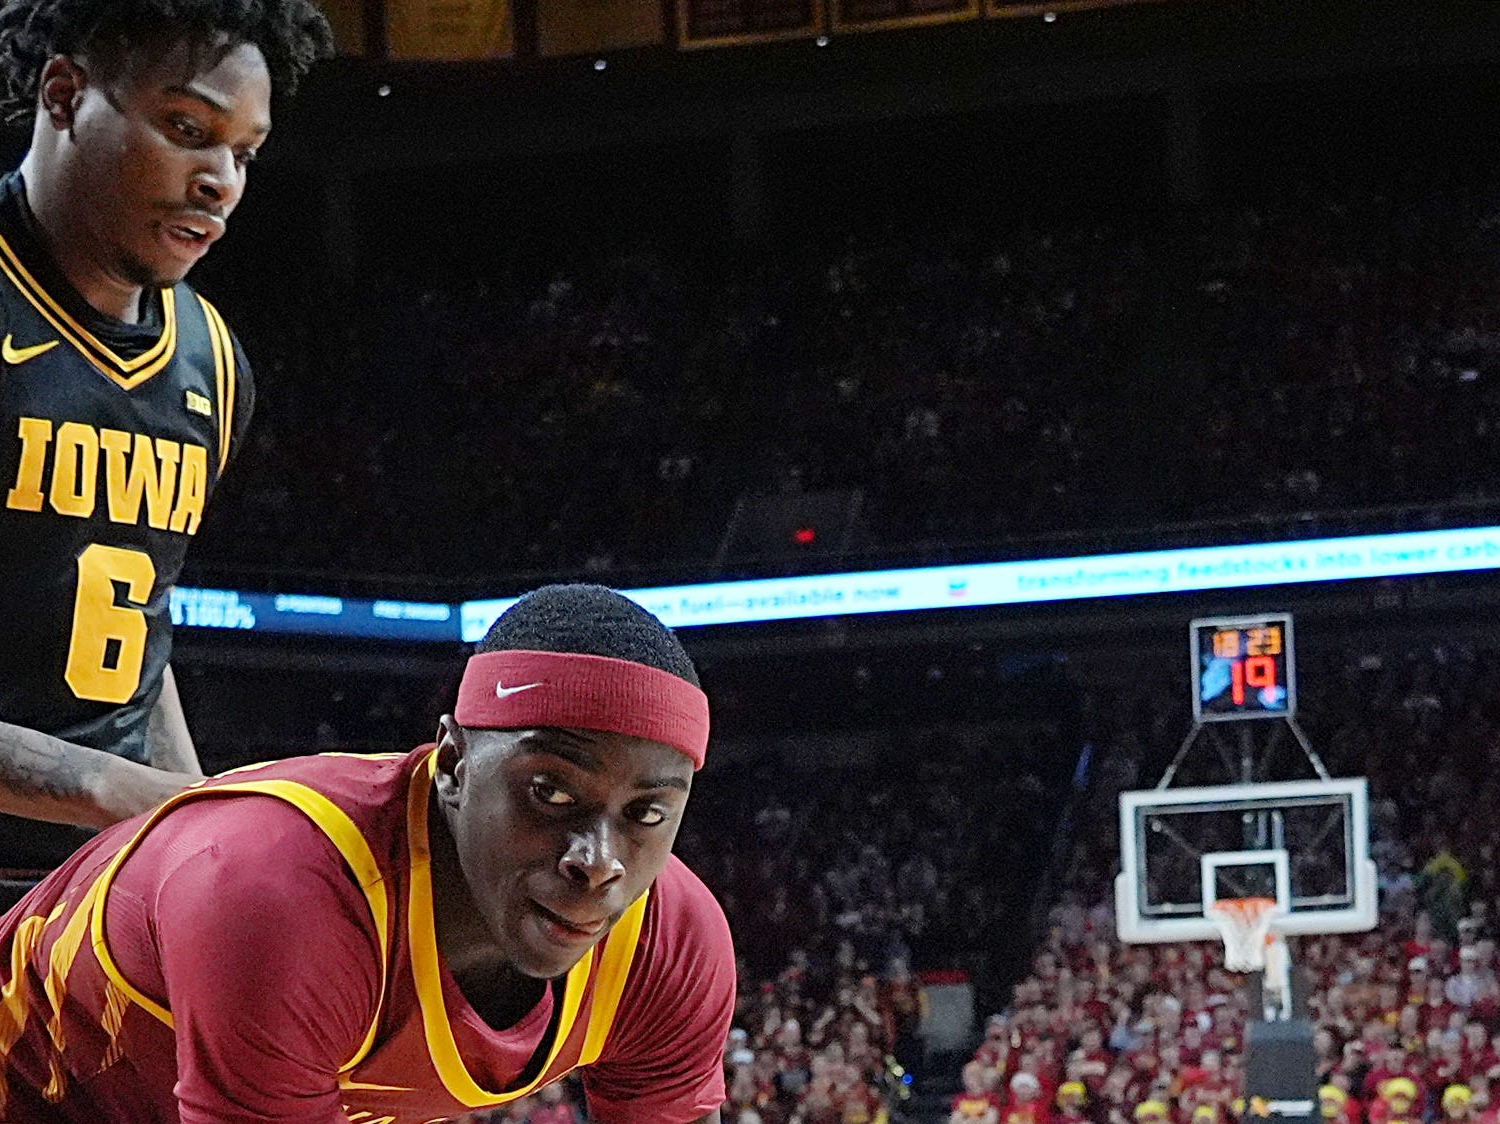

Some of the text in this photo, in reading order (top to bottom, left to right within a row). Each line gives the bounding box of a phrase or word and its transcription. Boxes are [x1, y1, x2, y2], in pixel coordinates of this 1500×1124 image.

[6, 417, 208, 536] IOWA
[1177, 554, 1307, 577] feedstocks
[1315, 551, 1363, 568] into
[1370, 547, 1437, 565] lower
[64, 543, 156, 704] 6
[1231, 654, 1277, 706] 19
